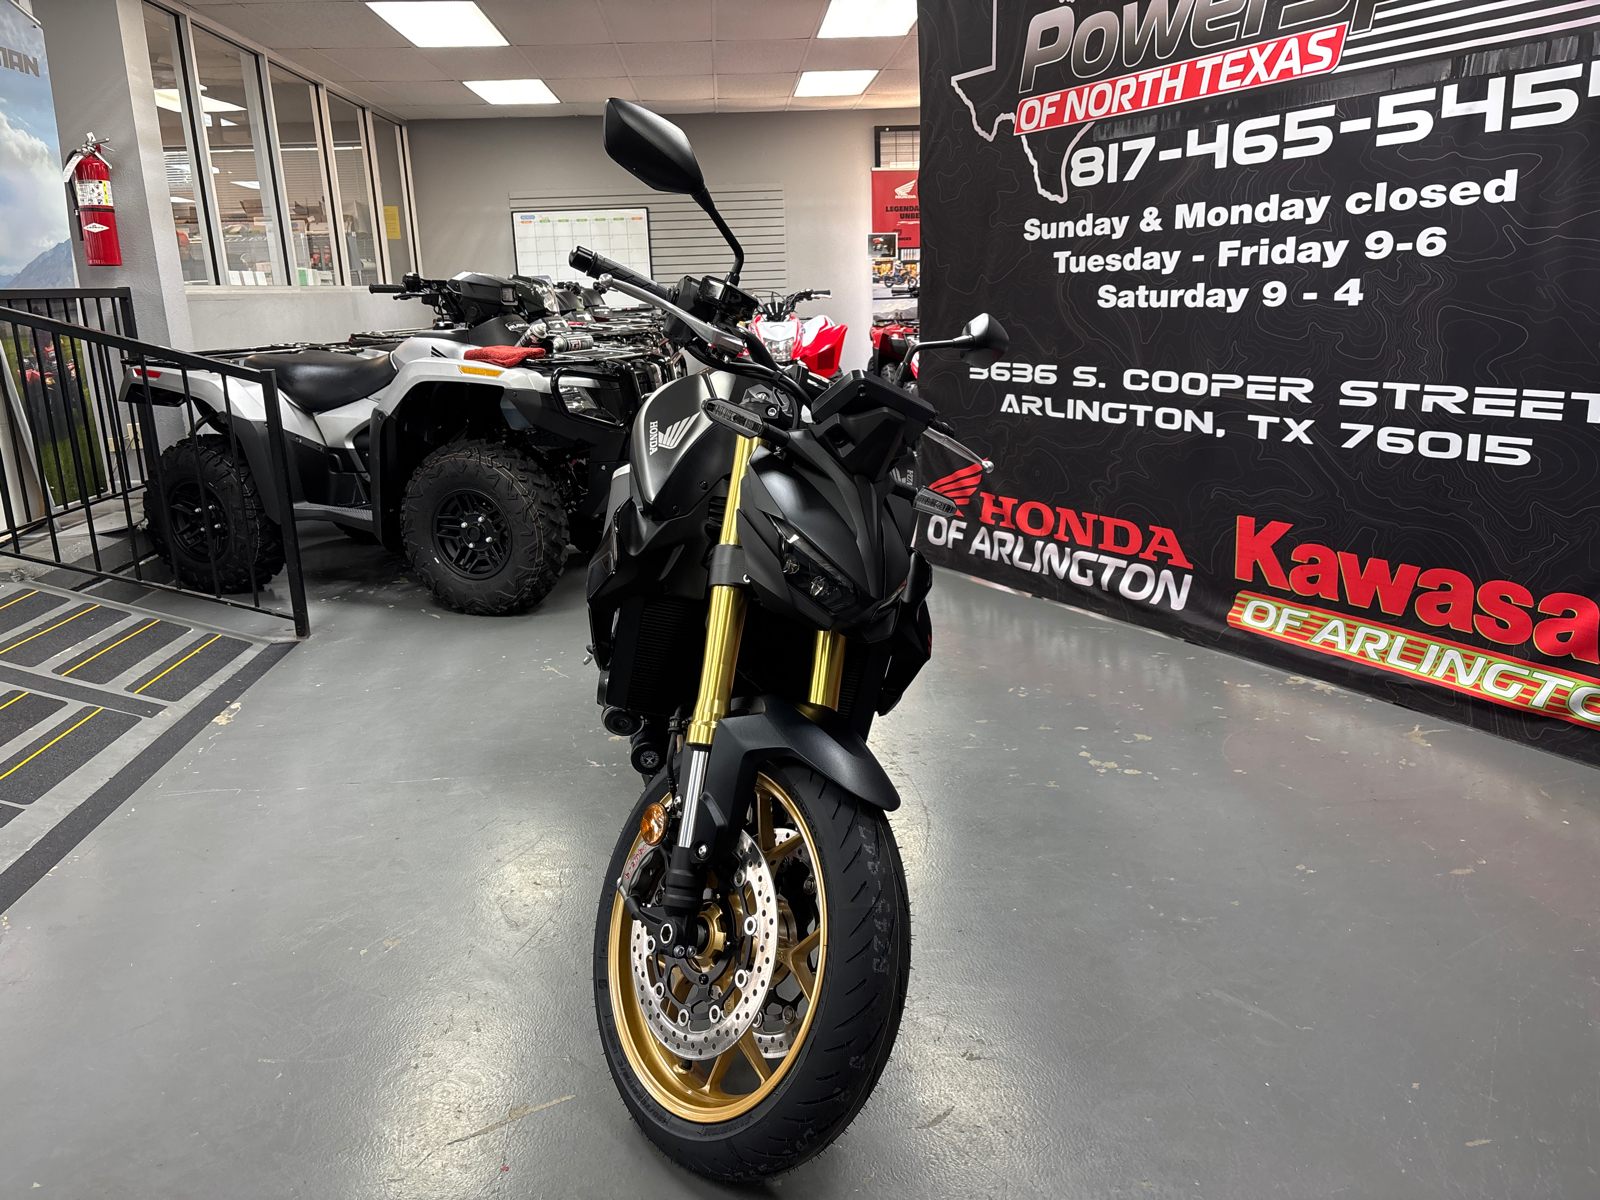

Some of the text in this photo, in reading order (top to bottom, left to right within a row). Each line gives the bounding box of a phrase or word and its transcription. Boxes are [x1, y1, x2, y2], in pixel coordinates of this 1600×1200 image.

[1020, 28, 1338, 131] OF NORTH TEXAS
[1024, 169, 1519, 241] Sunday & Monday closed
[1054, 227, 1447, 275] Tuesday - Friday 9-6
[1097, 278, 1364, 313] Saturday 9 - 4
[1000, 394, 1534, 466] ARLINGTON, TX 76015
[1073, 366, 1106, 389] S.
[1123, 369, 1315, 404] COOPER
[1339, 381, 1600, 424] STREET
[649, 421, 658, 456] HONDA
[928, 515, 1193, 611] OF ARLINGTON
[979, 492, 1194, 570] HONDA
[1234, 515, 1600, 665] Kawasa
[1243, 601, 1600, 723] OF ARLINGTO
